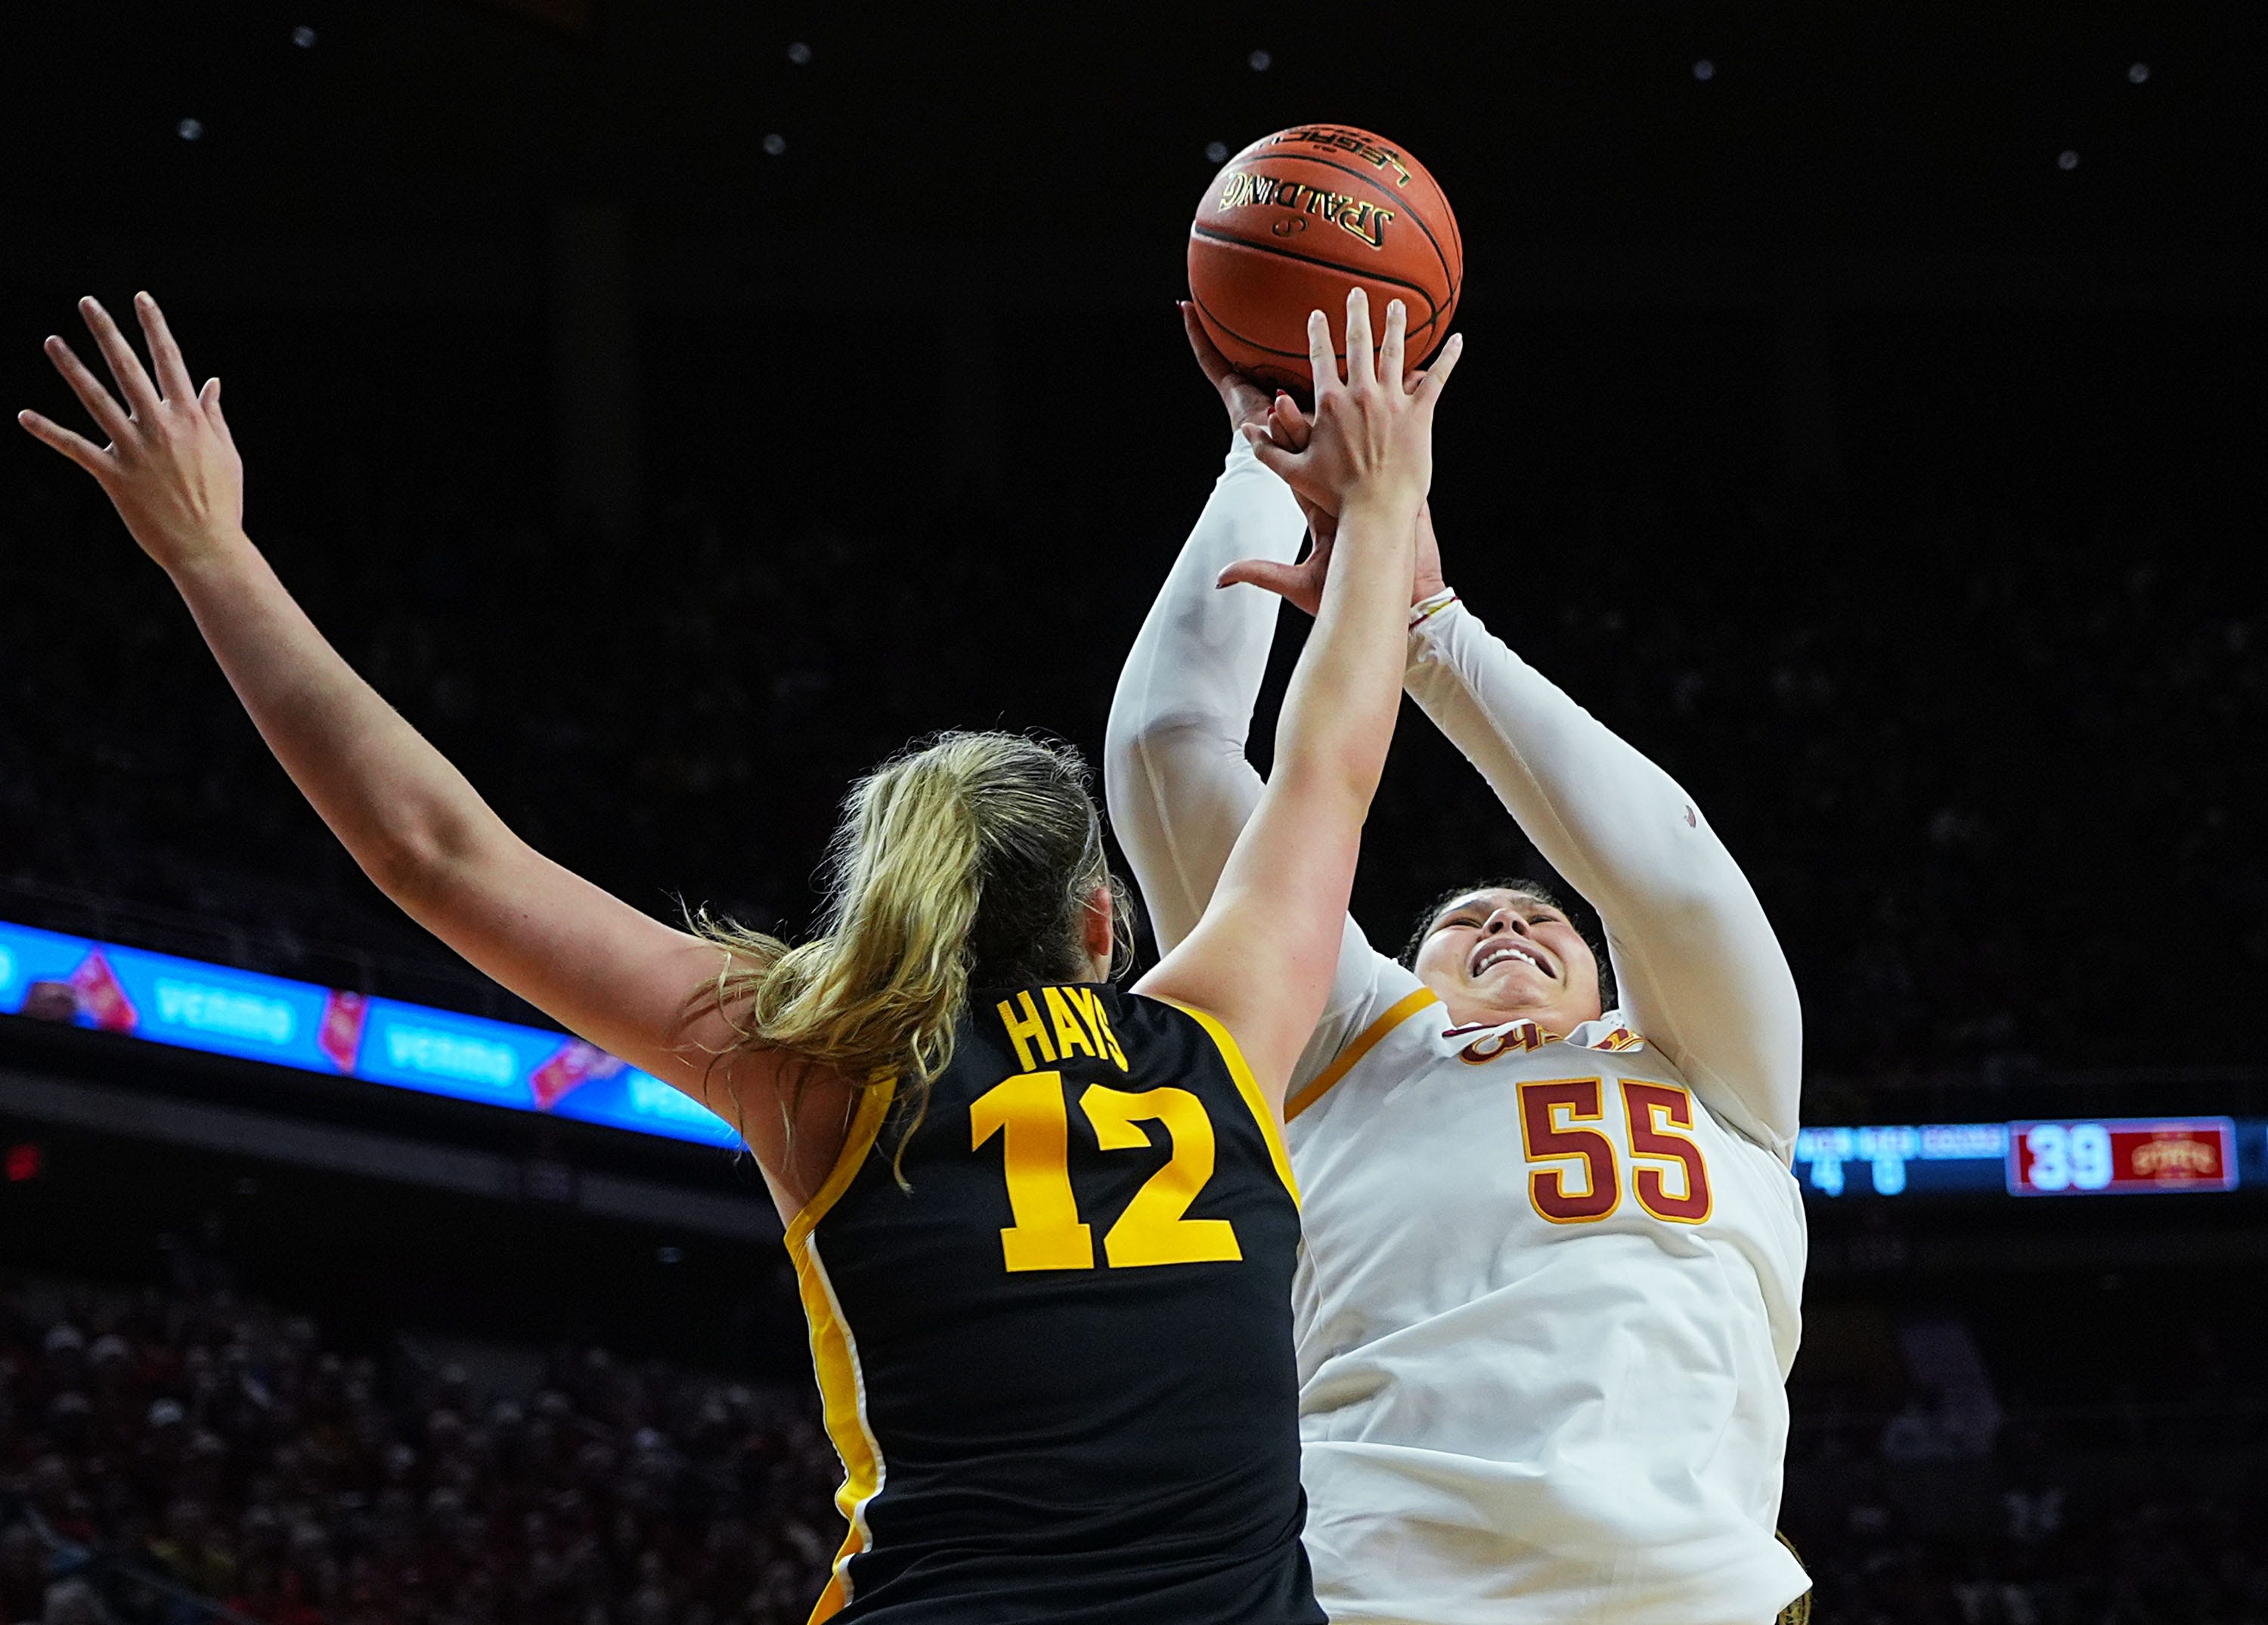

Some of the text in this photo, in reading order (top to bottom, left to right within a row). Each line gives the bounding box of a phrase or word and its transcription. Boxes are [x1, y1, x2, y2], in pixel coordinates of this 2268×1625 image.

[1217, 173, 1395, 250] SPALDING
[996, 987, 1129, 1072] HAYS
[970, 1071, 1243, 1272] 12
[1516, 1076, 1712, 1225] 55
[2026, 1124, 2114, 1191] 39
